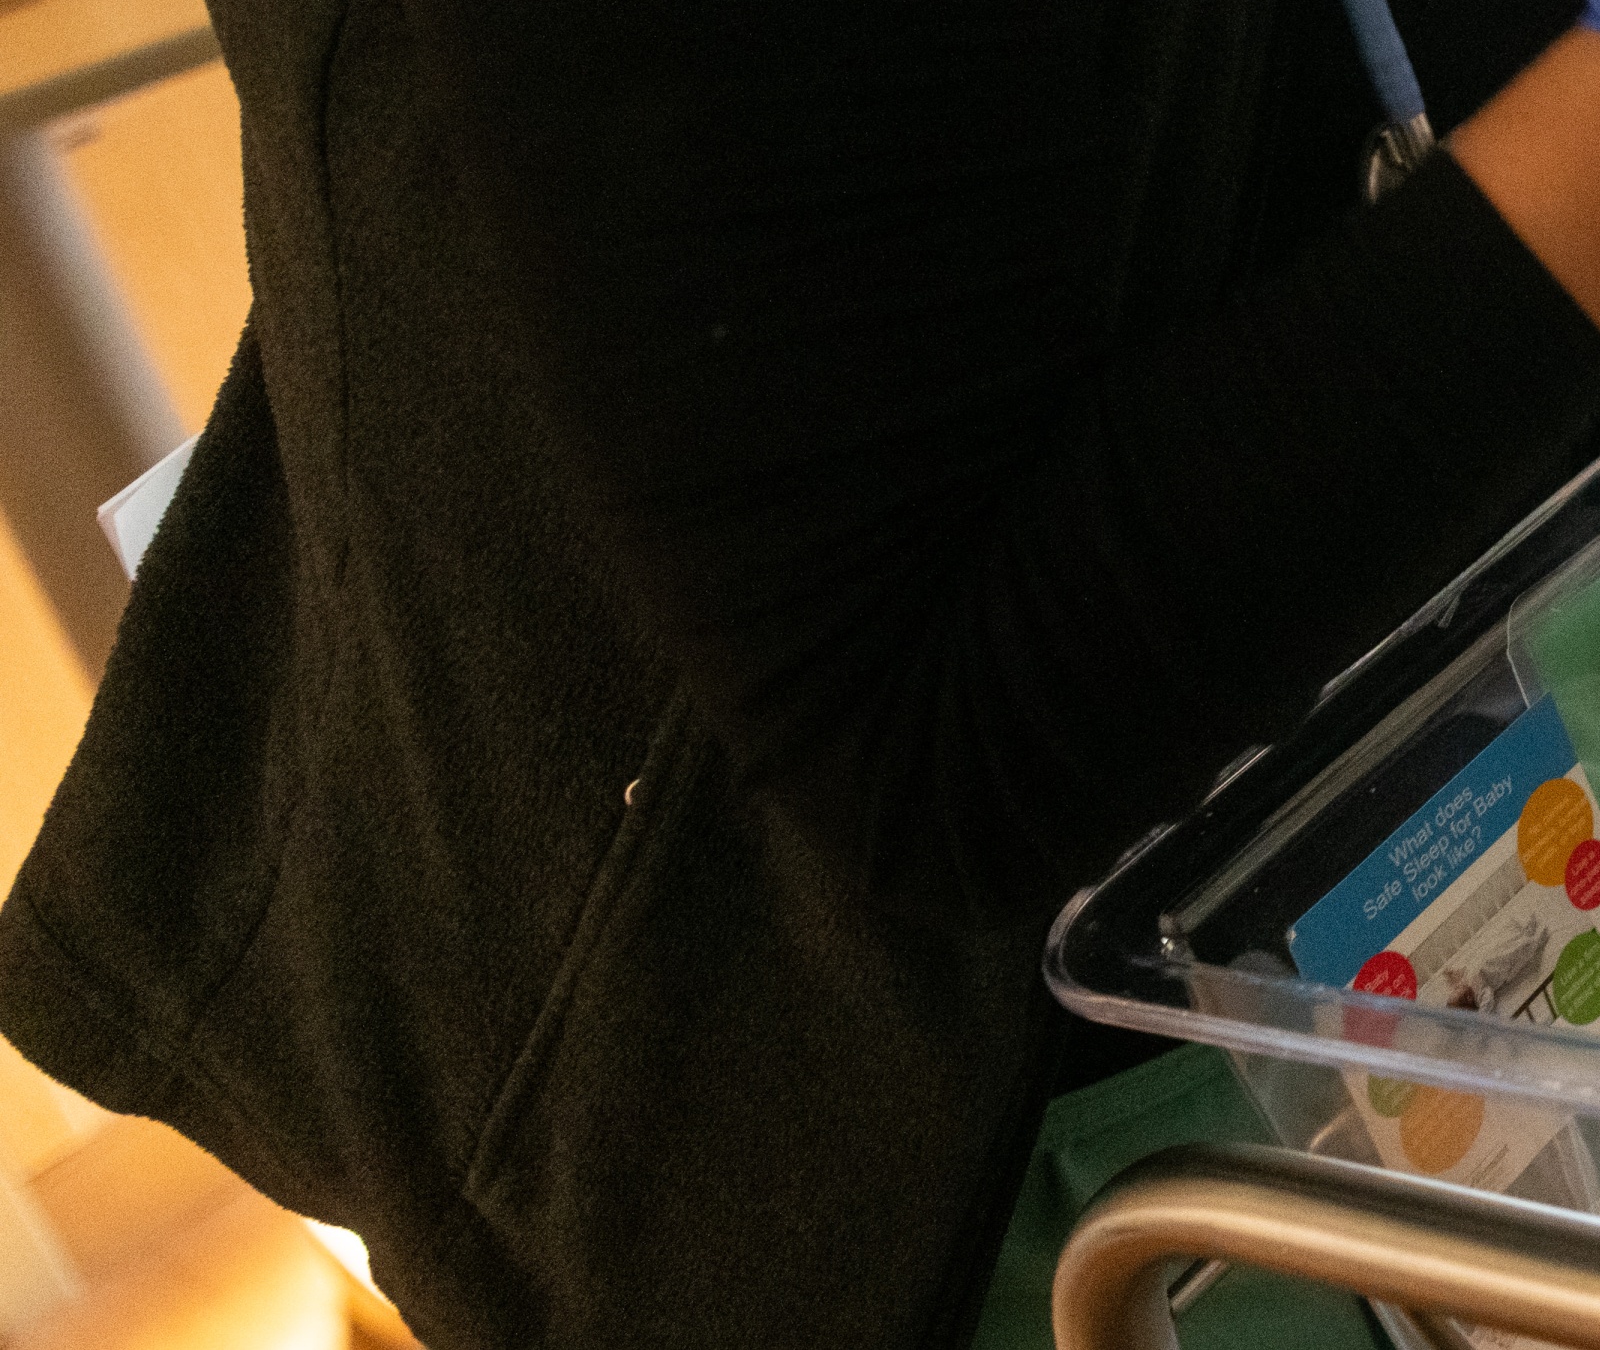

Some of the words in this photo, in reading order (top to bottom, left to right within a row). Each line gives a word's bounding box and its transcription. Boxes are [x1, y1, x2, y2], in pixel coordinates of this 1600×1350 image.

[1363, 879, 1402, 920] Safe
[1403, 835, 1450, 883] Sleep
[1450, 811, 1472, 839] for
[1473, 775, 1514, 817] Baby
[1388, 821, 1434, 867] What
[1435, 787, 1473, 827] does
[1411, 864, 1447, 902] look
[1447, 825, 1482, 868] like?
